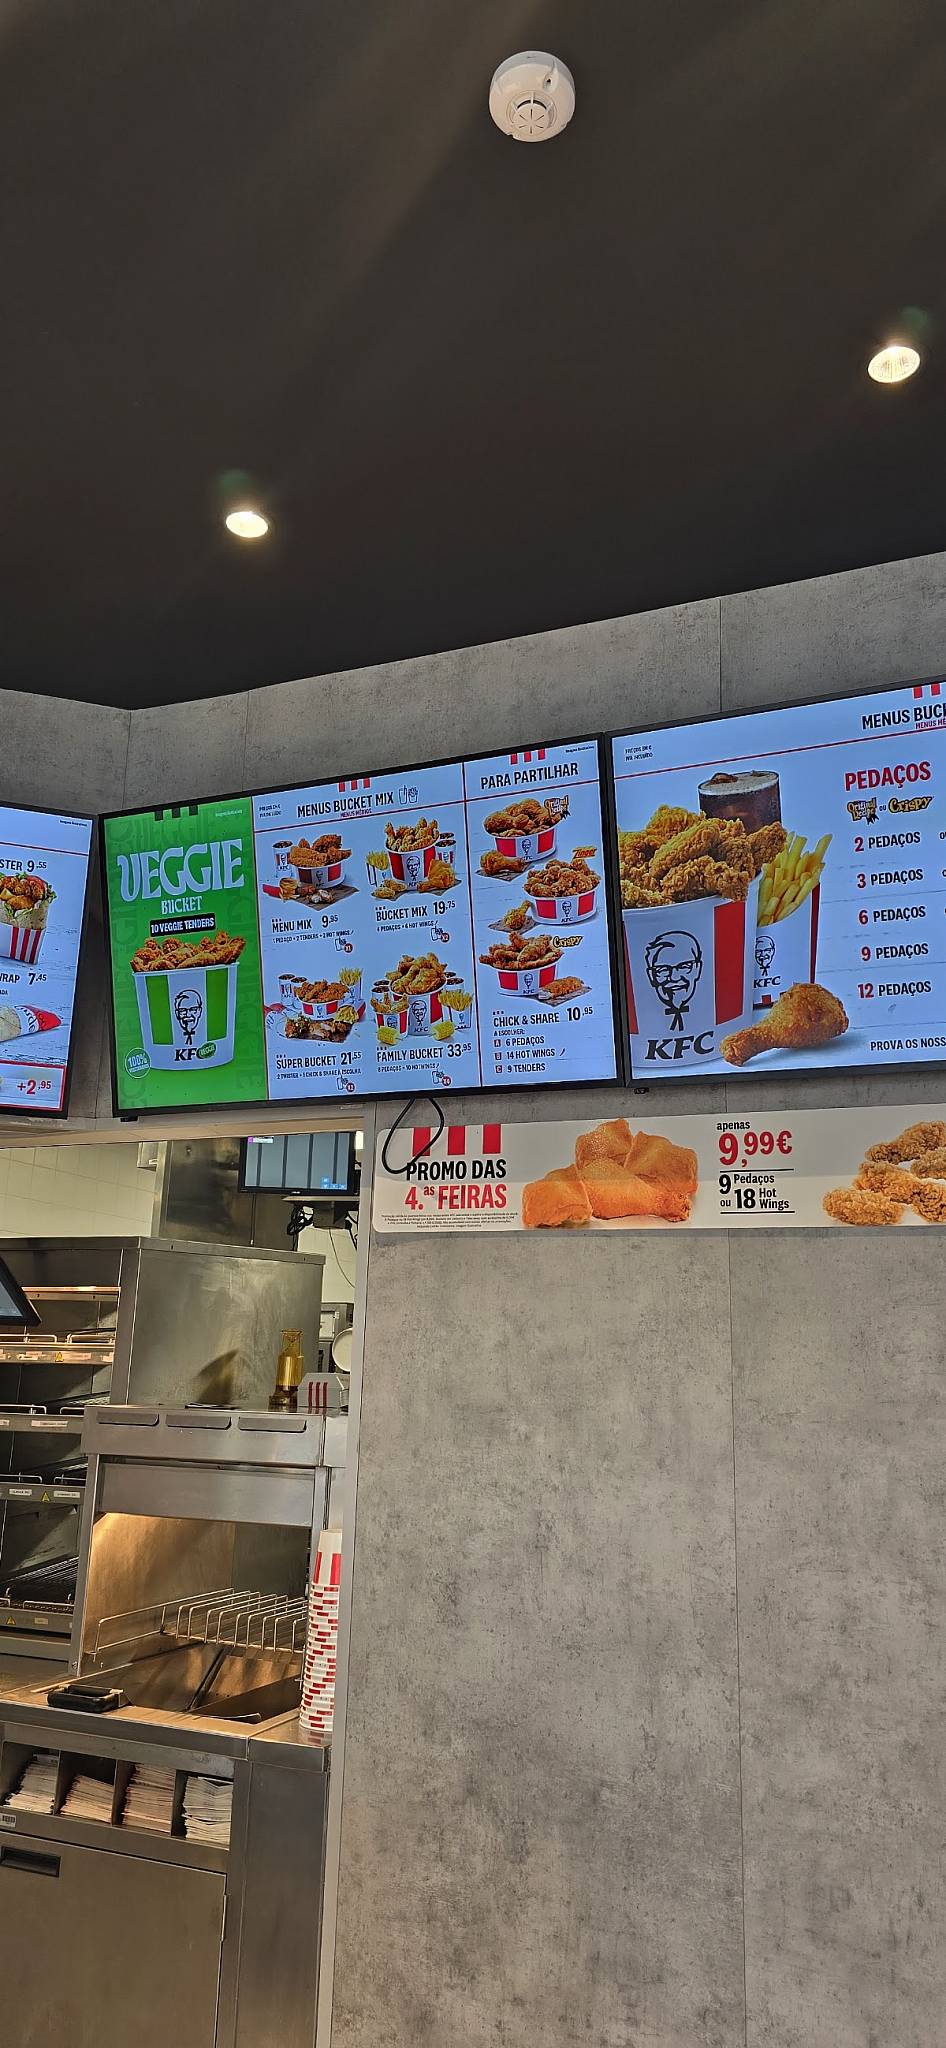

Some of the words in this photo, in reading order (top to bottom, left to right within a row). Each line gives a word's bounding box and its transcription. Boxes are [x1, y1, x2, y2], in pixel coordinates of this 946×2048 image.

[862, 710, 910, 730] MENUS
[916, 720, 937, 730] MENUS
[481, 774, 512, 790] PARA
[514, 763, 578, 784] PARTILHAR
[845, 761, 931, 791] PEDAÇOS
[298, 800, 331, 818] MENUS
[334, 795, 372, 812] BUCKET
[376, 792, 394, 806] MIX
[889, 796, 932, 813] Crispy
[854, 837, 864, 852] 2
[868, 832, 920, 849] PEDAÇOS
[118, 838, 244, 902] VEGGIE
[857, 874, 866, 889] 3
[870, 869, 923, 886] PEDAÇOS
[161, 896, 203, 914] BUCKET
[376, 908, 409, 922] BUCKET
[412, 906, 428, 917] MIX
[859, 910, 868, 924] 6
[873, 906, 926, 922] PEDAÇOS
[151, 924, 159, 934] 10
[160, 921, 184, 933] VEGGIE
[185, 918, 214, 930] TENDERS
[272, 920, 294, 933] MENU
[297, 919, 312, 929] MIX
[553, 936, 583, 948] Crispy
[861, 946, 871, 961] 9
[875, 943, 929, 960] PEDAÇOS
[753, 976, 781, 988] KFC
[857, 984, 874, 999] 12
[878, 981, 931, 997] PEDAÇOS
[494, 1016, 519, 1027] CHICK
[522, 1016, 528, 1025] &
[530, 1012, 559, 1025] SHARE
[567, 1007, 593, 1021] 10,95
[512, 1036, 544, 1046] PEDAÇOS
[645, 1031, 715, 1060] KFC
[870, 1040, 904, 1051] PROVA
[906, 1039, 918, 1049] OS
[128, 1054, 148, 1067] 100%
[276, 1058, 303, 1069] SUPER
[305, 1056, 336, 1067] BUCKET
[377, 1051, 407, 1062] FAMILY
[410, 1048, 443, 1059] BUCKET
[507, 1051, 514, 1059] 14
[516, 1050, 530, 1058] HOT
[532, 1049, 555, 1058] WINGS
[513, 1063, 546, 1072] TENDERS
[716, 1120, 750, 1132] apenas
[718, 1130, 792, 1167] 9,99€
[406, 1160, 467, 1181] PROMO
[472, 1159, 507, 1179] DAS
[719, 1174, 731, 1194] 9
[734, 1174, 775, 1185] Pedaços
[438, 1184, 507, 1210] FEIRAS
[720, 1199, 731, 1207] ou
[735, 1189, 756, 1208] 18
[759, 1188, 777, 1197] Hot
[759, 1199, 790, 1210] Wings
